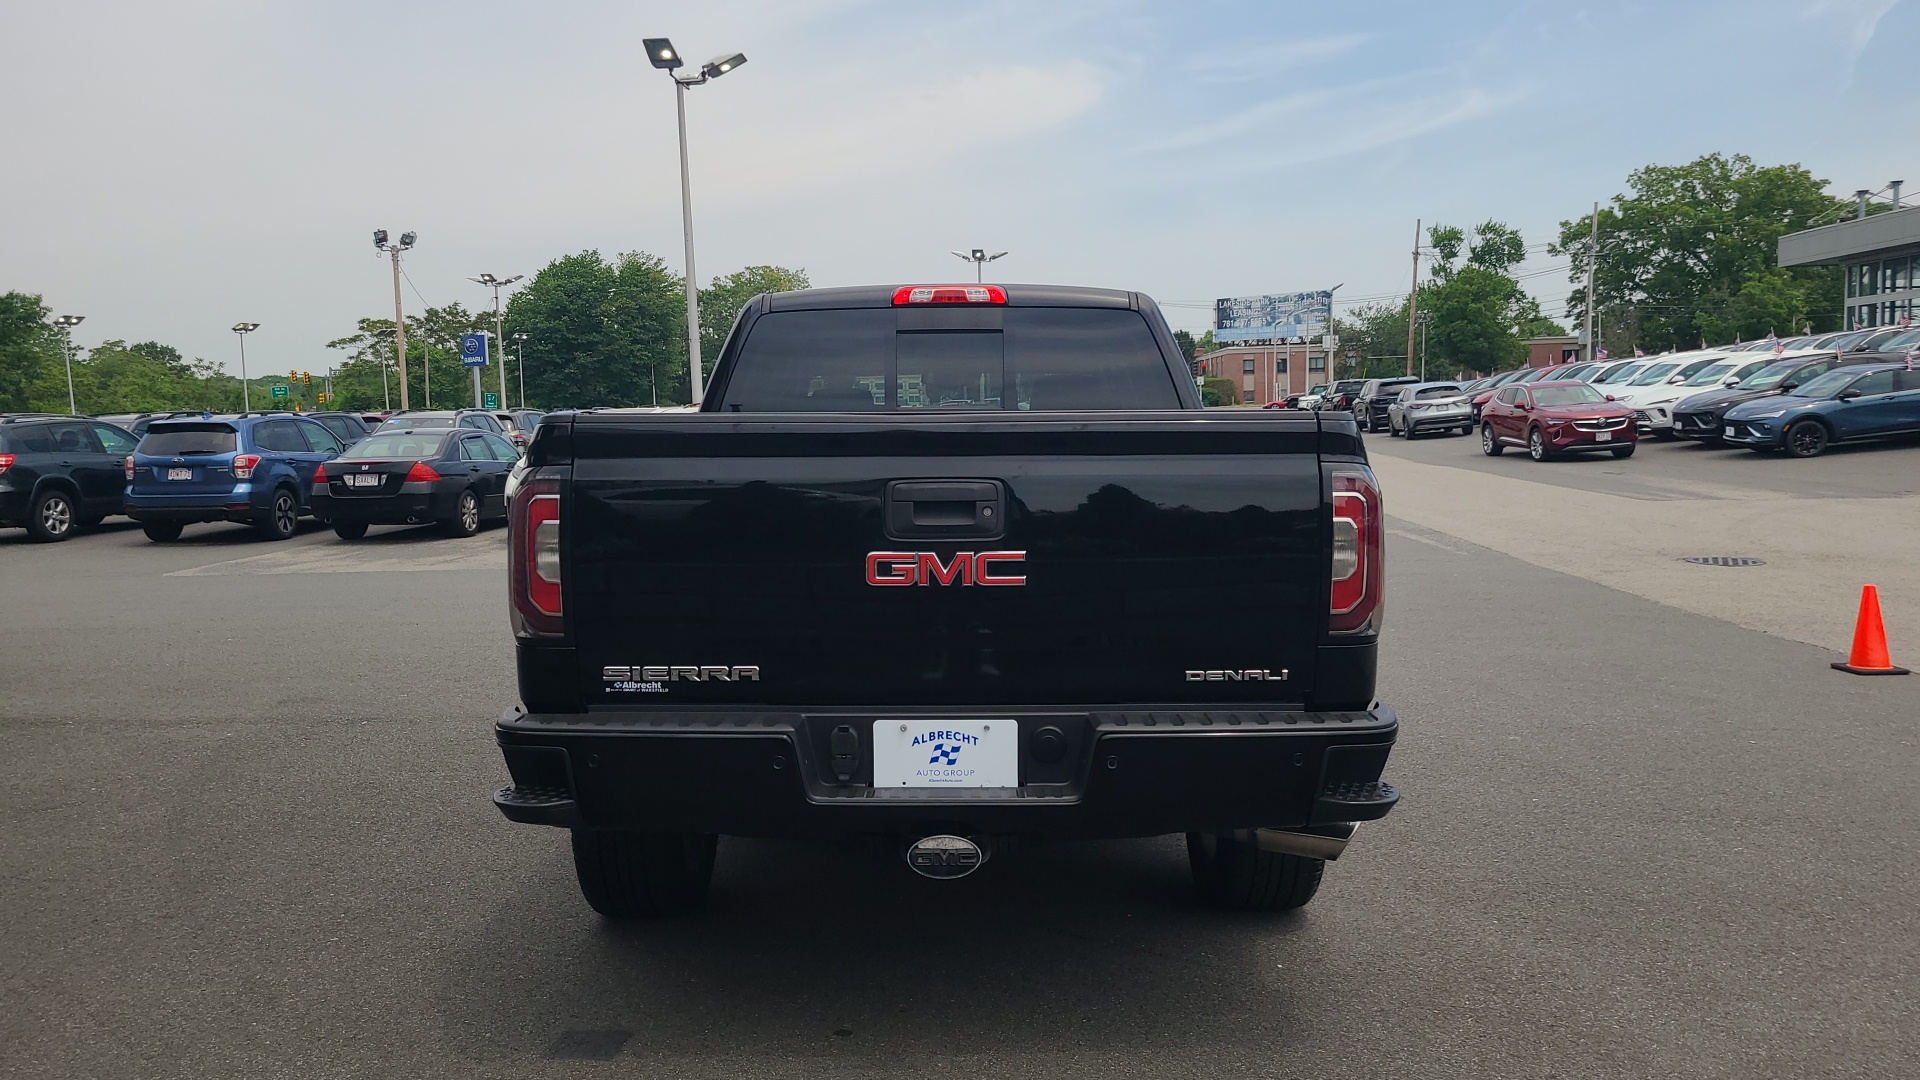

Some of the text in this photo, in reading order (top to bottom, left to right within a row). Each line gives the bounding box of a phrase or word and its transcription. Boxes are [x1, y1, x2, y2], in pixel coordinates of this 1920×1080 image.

[865, 550, 1027, 587] GMC
[602, 665, 760, 682] SIERRA
[1185, 669, 1289, 681] DENALI
[622, 681, 662, 689] Albrecht
[911, 730, 979, 747] ALBRECHT
[916, 769, 975, 777] AUTO GROUP
[914, 848, 977, 866] GMC
